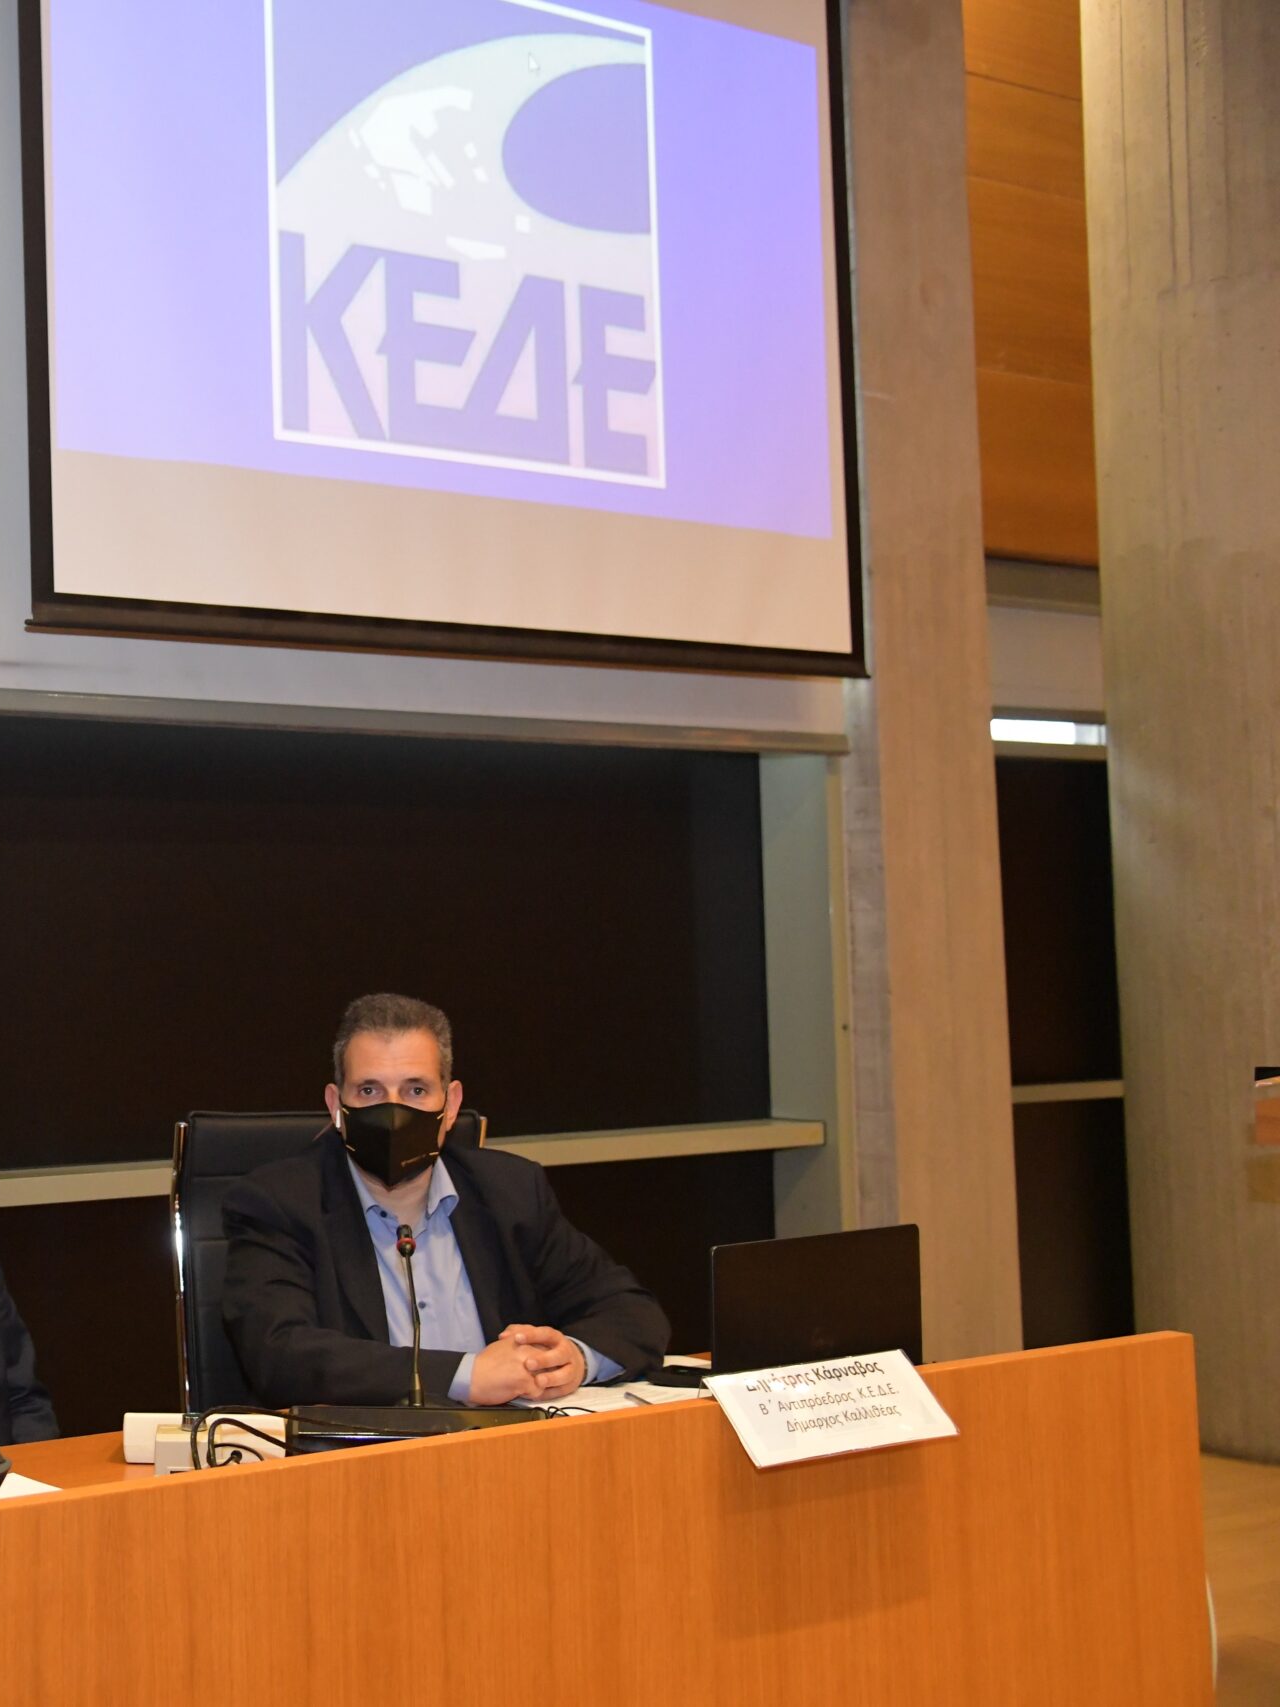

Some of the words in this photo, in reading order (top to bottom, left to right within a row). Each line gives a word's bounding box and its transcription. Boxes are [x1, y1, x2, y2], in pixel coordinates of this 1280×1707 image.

[277, 228, 657, 477] ΚΕΔΕ
[811, 1361, 885, 1382] Κάρναβος
[778, 1391, 857, 1413] Αντιπρόεδρος
[857, 1382, 900, 1400] Κ.Ε.Δ.Ε.
[786, 1414, 845, 1433] Δήμαρχος
[842, 1404, 902, 1422] Καλλιθέας
